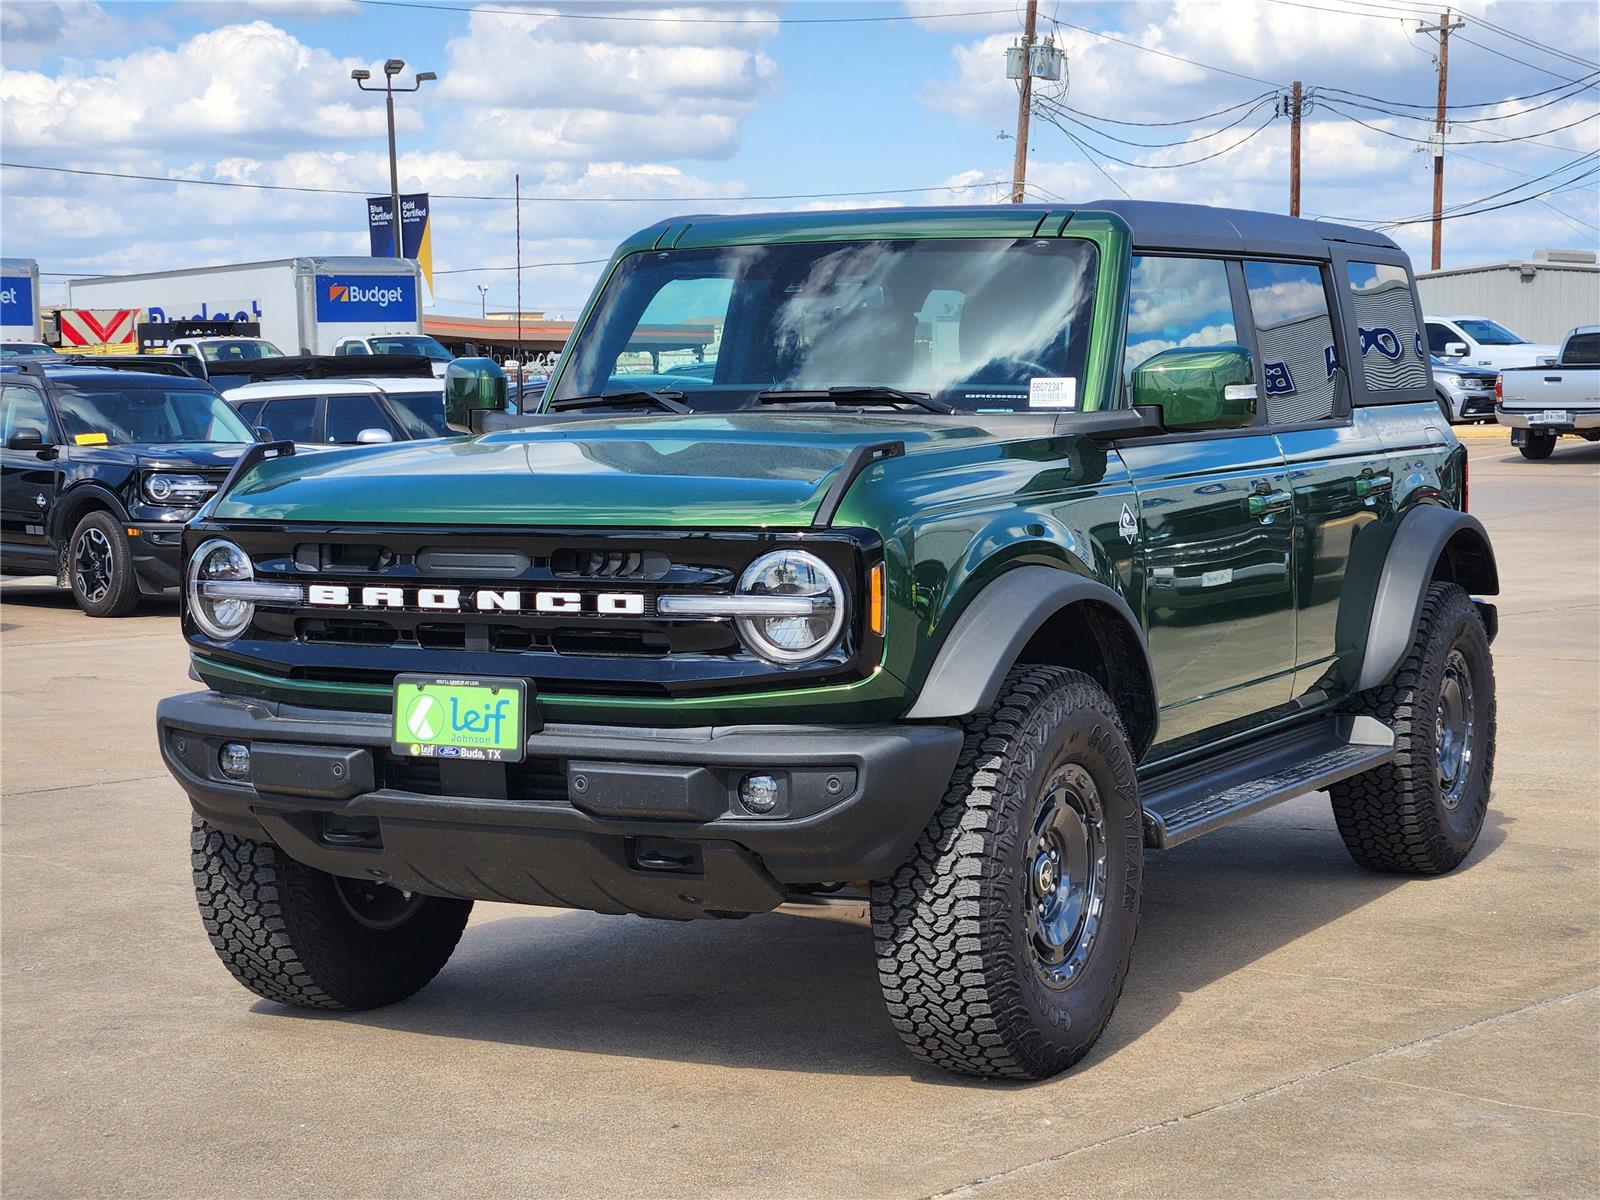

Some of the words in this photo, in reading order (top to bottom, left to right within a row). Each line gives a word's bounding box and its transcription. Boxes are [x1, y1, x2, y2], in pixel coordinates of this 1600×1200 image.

[370, 205, 383, 213] Blue
[402, 201, 415, 210] Gold
[371, 212, 393, 222] Certified
[403, 208, 426, 218] Certified
[350, 286, 403, 307] Budget
[309, 585, 645, 614] BRONCO
[450, 733, 491, 744] Johnson
[460, 748, 486, 760] Buda,
[487, 749, 501, 760] TX
